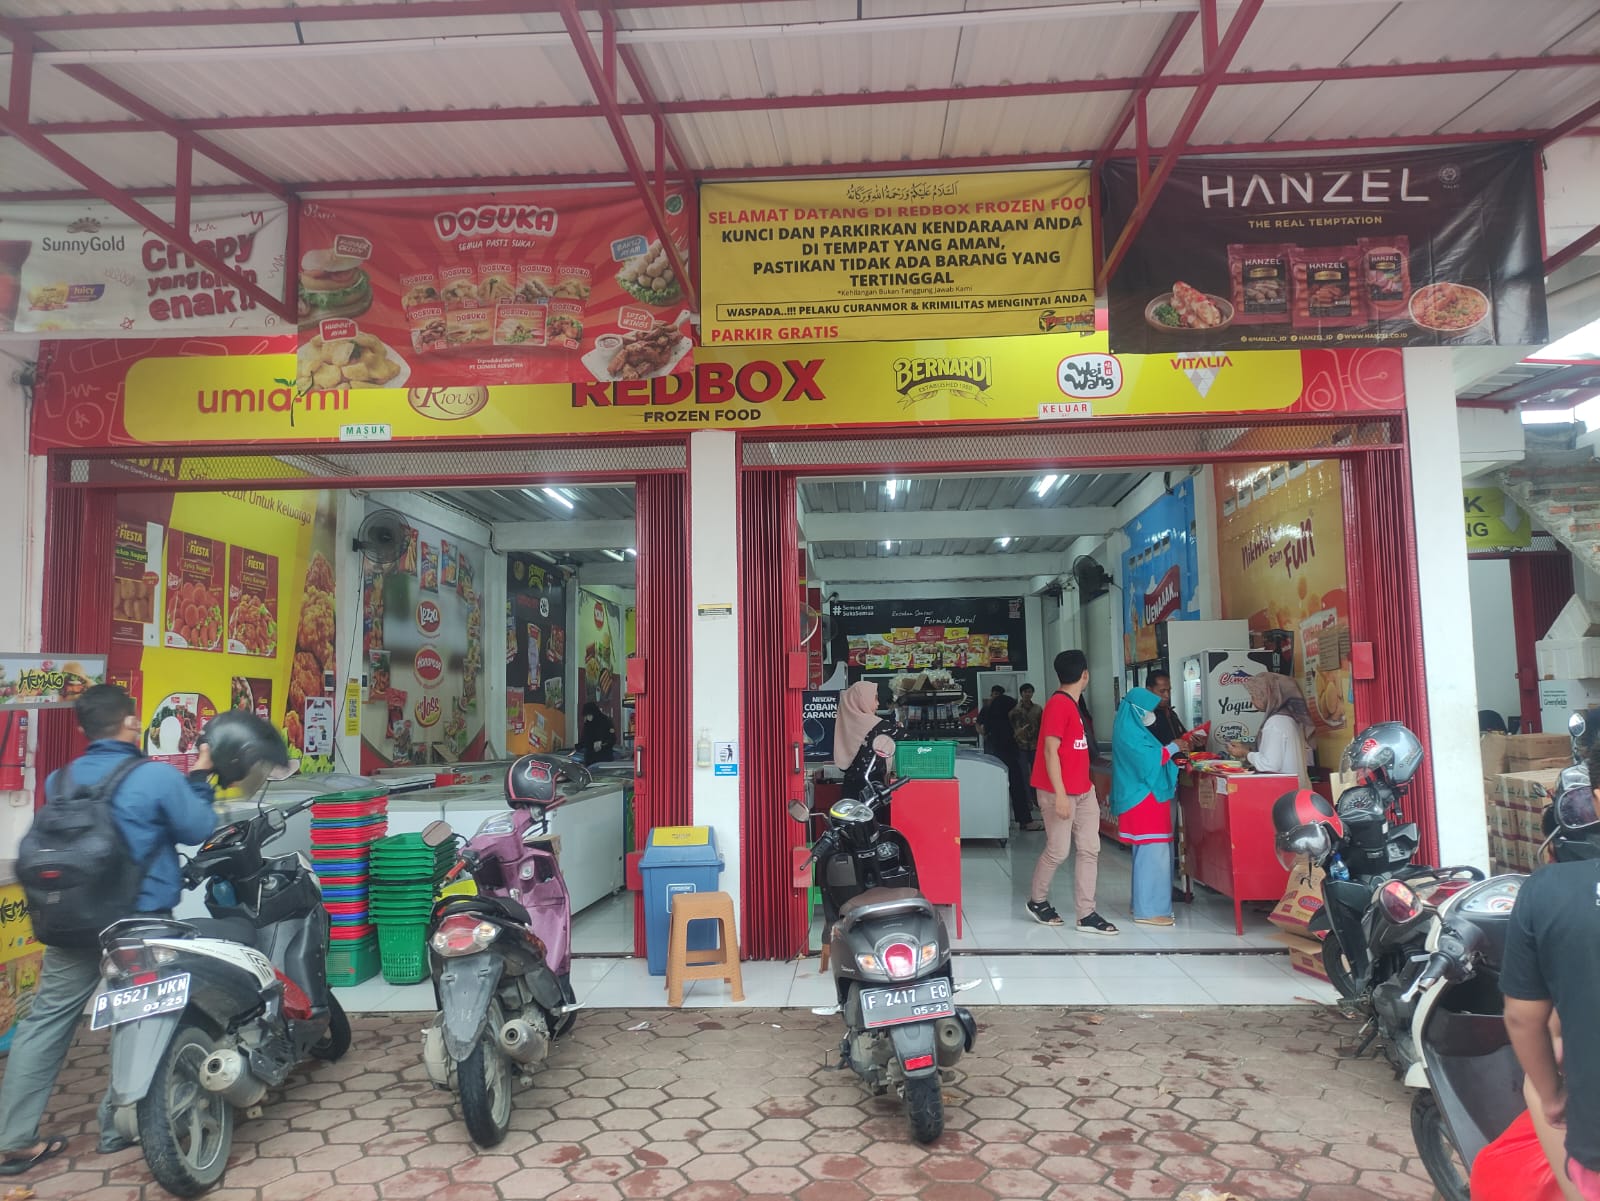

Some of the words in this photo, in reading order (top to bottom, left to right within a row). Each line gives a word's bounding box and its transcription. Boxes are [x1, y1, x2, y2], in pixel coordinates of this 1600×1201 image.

[1202, 168, 1429, 208] HANZEL
[708, 208, 789, 225] SELAMAT
[794, 207, 869, 221] DATANG
[874, 207, 892, 218] DI
[898, 203, 970, 217] REDBOX
[975, 199, 1045, 214] FROZEN
[435, 206, 558, 240] DOSUKA
[722, 228, 773, 243] KUNCI
[778, 226, 815, 241] DAN
[820, 222, 917, 239] PARKIRKAN
[922, 218, 1028, 235] KENDARAAN
[1033, 216, 1083, 230] ANDA
[1248, 220, 1271, 229] THE
[1275, 218, 1305, 228] REAL
[1309, 215, 1382, 226] TEMPTATION
[42, 235, 125, 255] SunnyGold
[458, 240, 483, 251] SEMUA
[486, 239, 508, 248] PASTI
[802, 243, 819, 256] DI
[823, 240, 890, 255] TEMPAT
[893, 238, 942, 252] YANG
[947, 237, 1006, 250] AMAN,
[753, 259, 835, 275] PASTIKAN
[840, 257, 891, 271] TIDAK
[895, 255, 931, 269] ADA
[935, 252, 1007, 267] BARANG
[1012, 251, 1061, 265] YANG
[148, 272, 199, 297] yang
[850, 271, 954, 287] TERTINGGAL
[900, 287, 933, 295] Tanggung
[934, 286, 954, 294] Jawab
[727, 307, 796, 317] WASPADA..!!!
[799, 305, 840, 315] PELAKU
[843, 302, 907, 313] CURANMOR
[911, 302, 919, 311] &
[922, 300, 984, 310] KRIMILITAS
[987, 297, 1051, 308] MENGINTAI
[1054, 294, 1087, 304] ANDA
[711, 328, 773, 342] PARKIR
[777, 326, 839, 339] GRATIS
[1067, 361, 1102, 377] Wei
[1170, 355, 1233, 370] VITALIA
[893, 356, 992, 392] BERNARDI
[1064, 374, 1114, 390] Wang
[572, 358, 826, 407] REDBOX
[644, 410, 710, 422] FROZEN
[714, 408, 761, 421] FOOD
[1043, 404, 1087, 413] KELUAR
[346, 425, 385, 435] MASUK
[248, 490, 275, 511] Untuk
[276, 499, 312, 527] Keluarga
[120, 528, 143, 543] FIESTA
[190, 544, 209, 558] FIESTA
[248, 559, 265, 571] FIESTA
[924, 615, 953, 625] Formula
[804, 703, 837, 711] COBAIN
[98, 996, 107, 1012] B
[114, 988, 148, 1007] 6521
[158, 977, 187, 996] WKN
[867, 995, 876, 1009] F
[885, 989, 916, 1007] 2417
